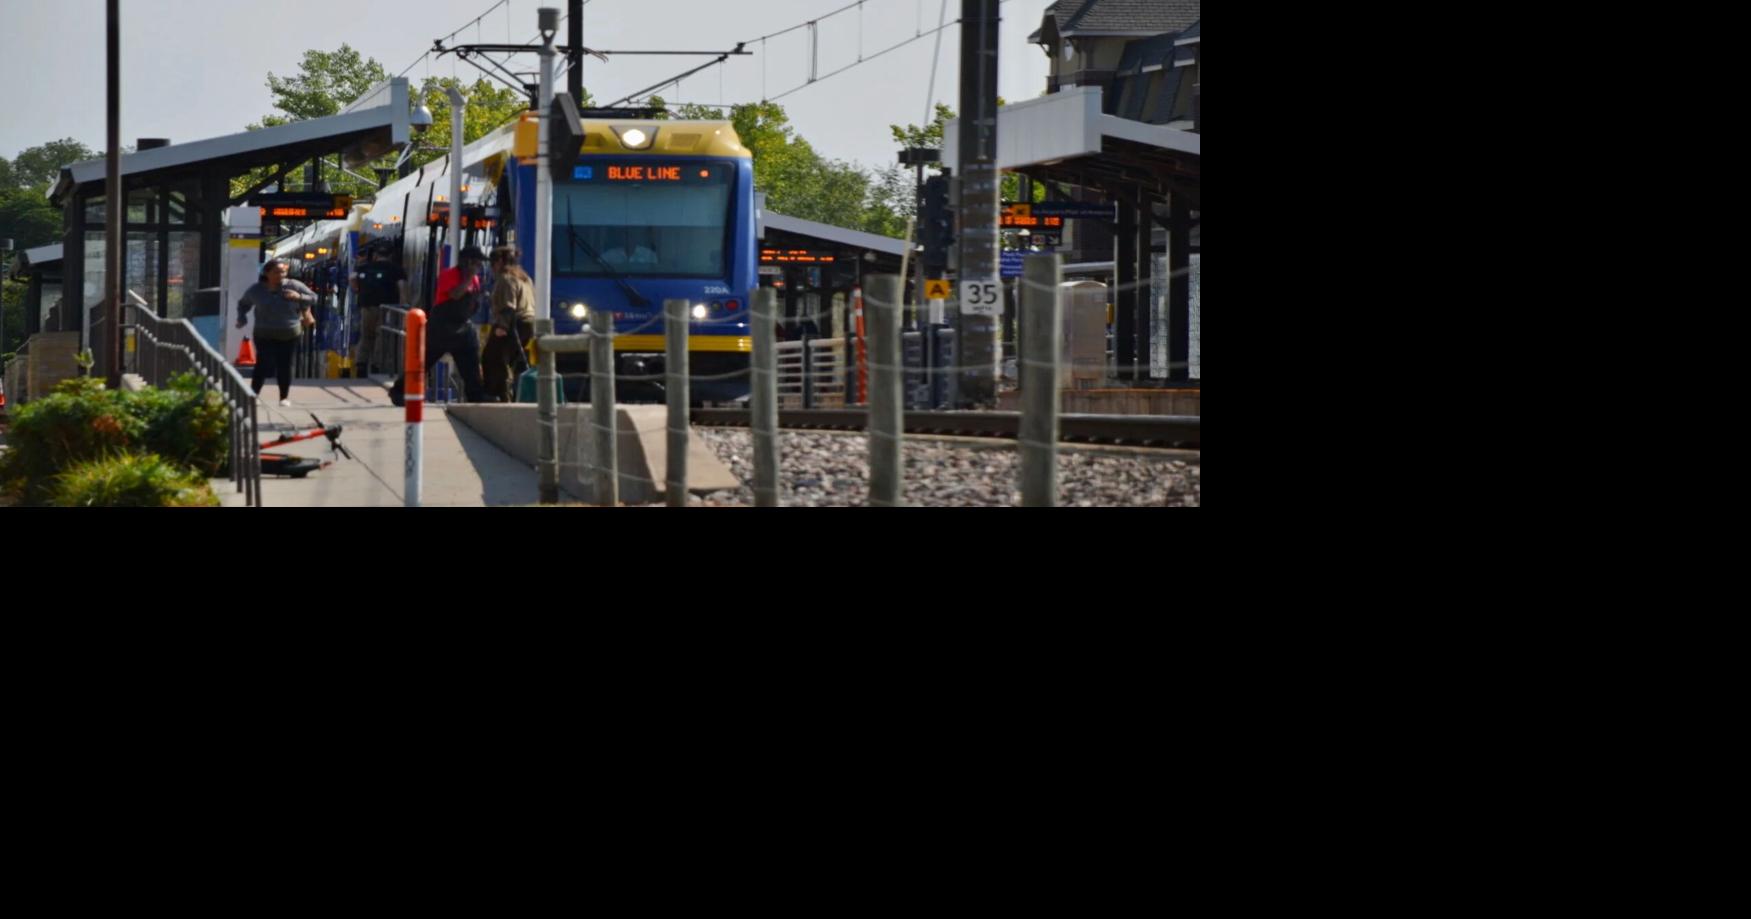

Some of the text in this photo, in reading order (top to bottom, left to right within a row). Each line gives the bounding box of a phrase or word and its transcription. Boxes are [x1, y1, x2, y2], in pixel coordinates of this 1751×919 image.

[608, 166, 642, 180] BLUE
[647, 166, 680, 180] LINE
[929, 283, 945, 296] A
[968, 284, 997, 304] 35
